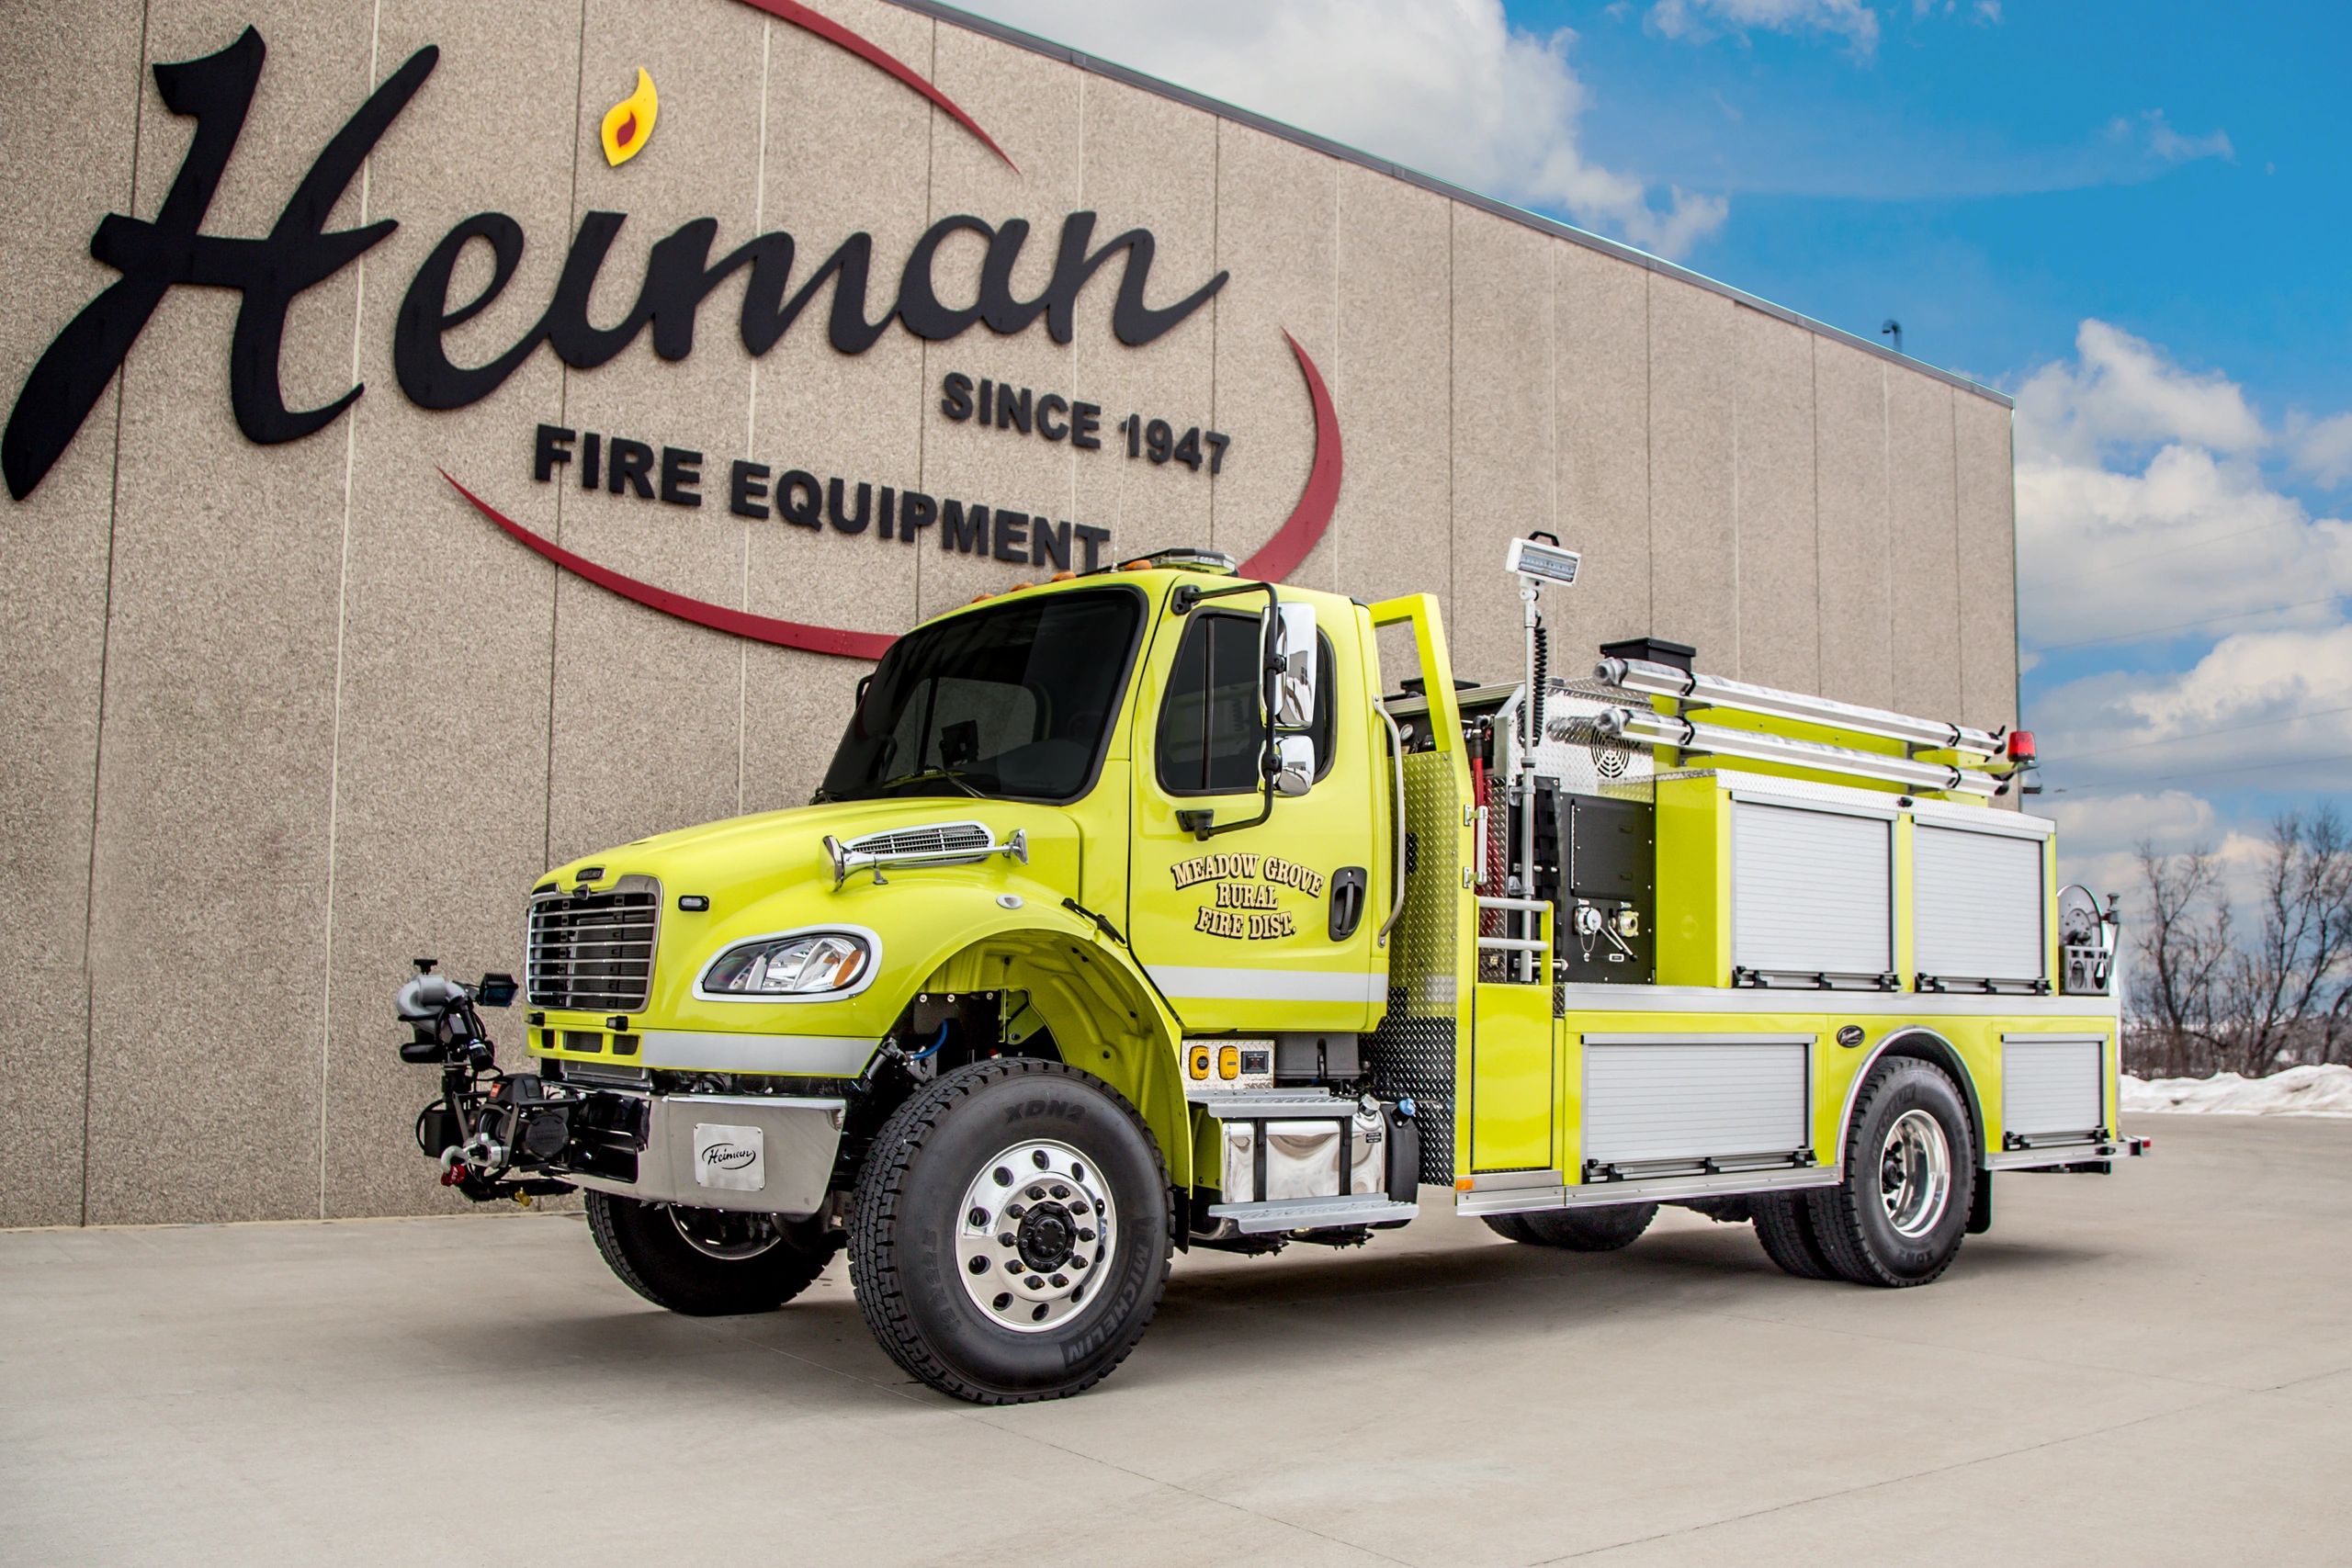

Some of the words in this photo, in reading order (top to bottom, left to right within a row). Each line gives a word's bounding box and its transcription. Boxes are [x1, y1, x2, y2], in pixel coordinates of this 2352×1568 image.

[0, 24, 1230, 502] Heiman
[941, 371, 1102, 449] SINCE
[1120, 412, 1231, 475] 1947
[534, 423, 704, 507] FIRE
[729, 458, 1111, 573] EQUIPMENT
[1170, 852, 1260, 890] MEADOW
[1263, 856, 1326, 897] GROVE
[1216, 883, 1278, 909] RURAL
[1194, 906, 1245, 940] FIRE
[1248, 911, 1297, 940] DIST.
[1006, 1100, 1087, 1125] XDN2
[1066, 1243, 1150, 1364] MICHELIN
